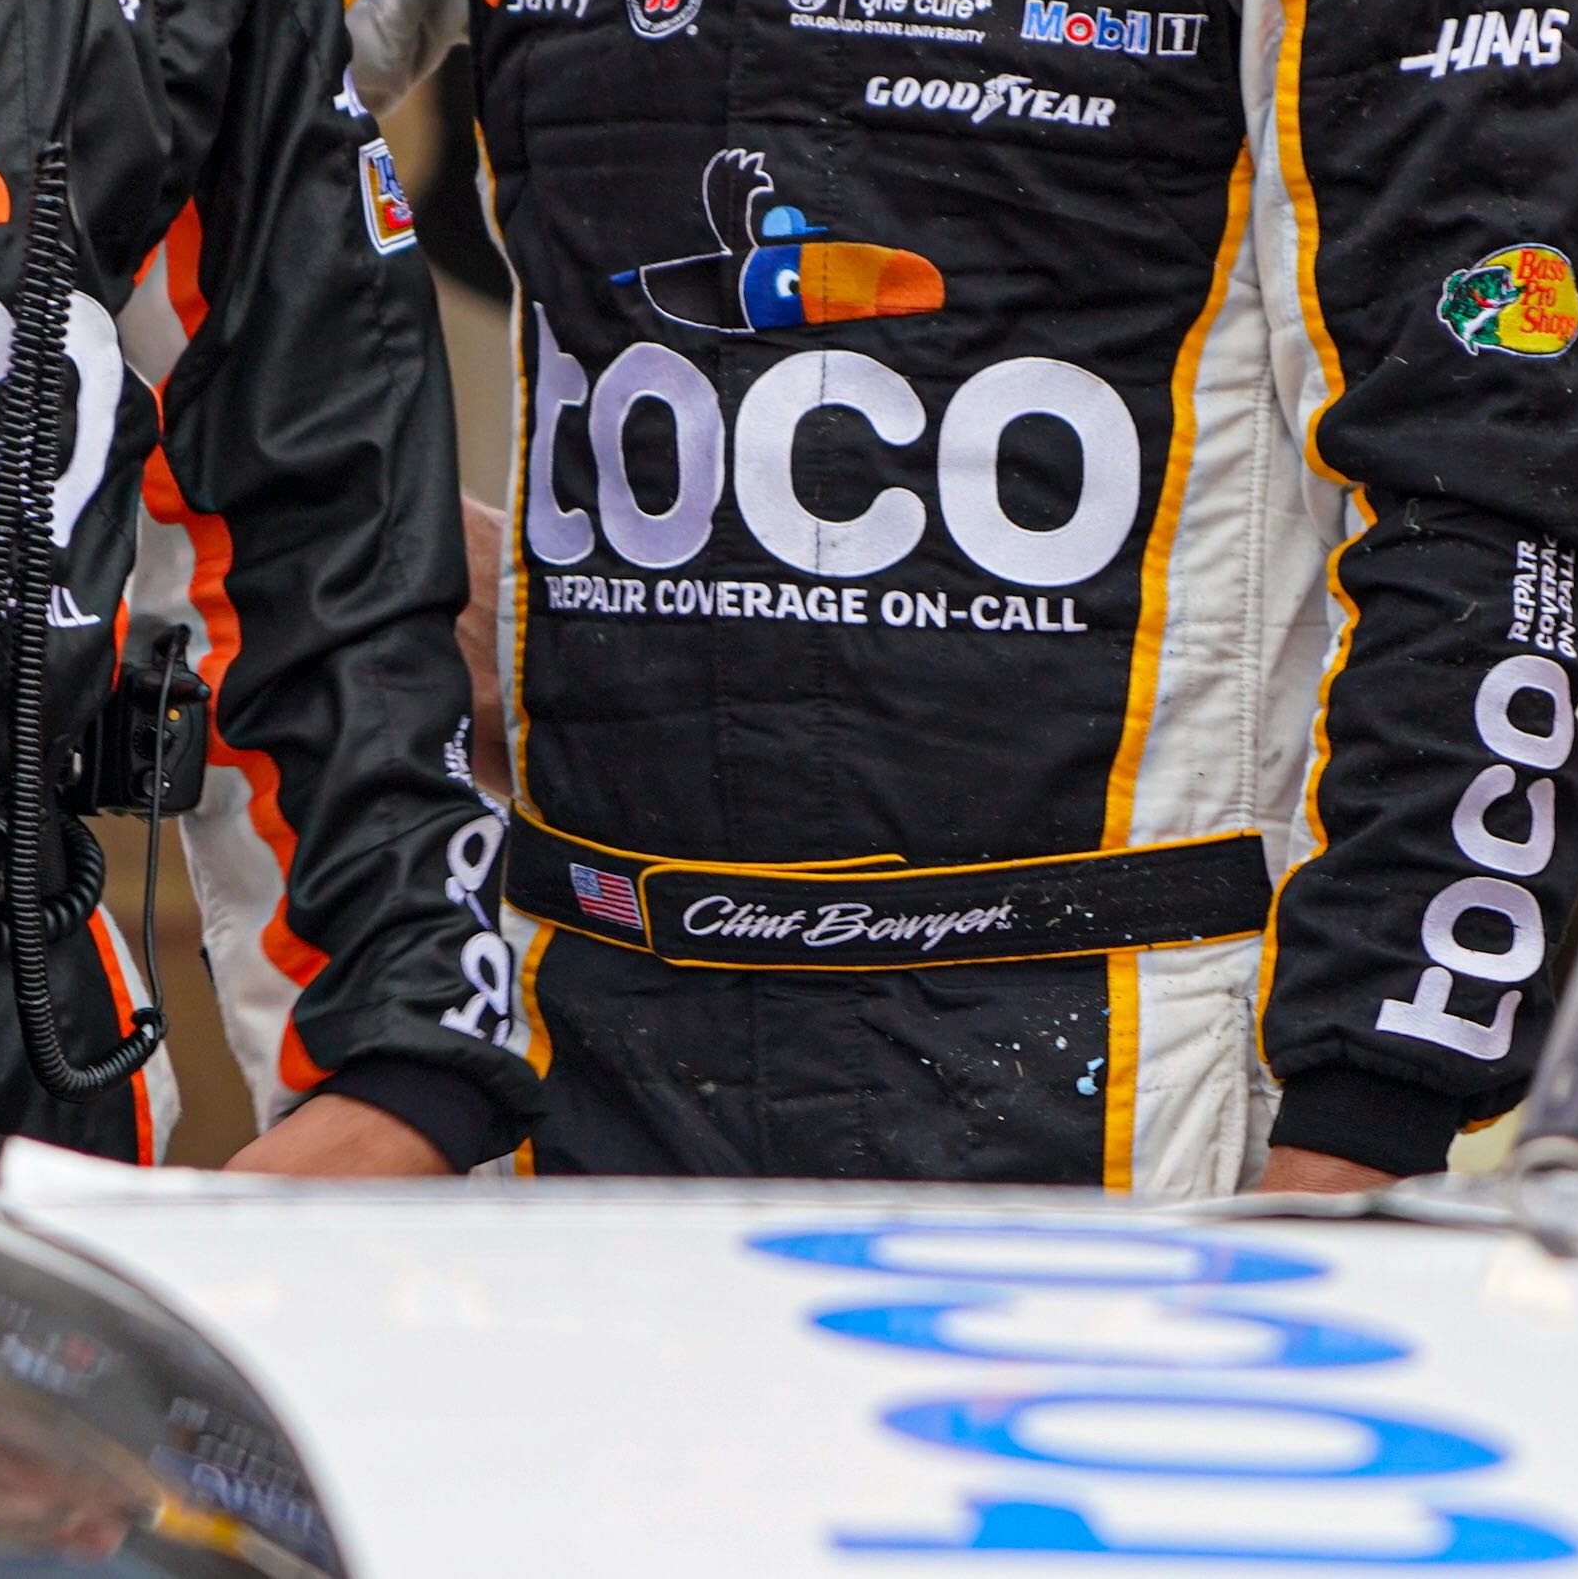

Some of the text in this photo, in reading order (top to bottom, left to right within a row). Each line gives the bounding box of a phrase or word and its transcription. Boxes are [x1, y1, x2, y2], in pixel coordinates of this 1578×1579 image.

[790, 13, 986, 44] COLORADO STATE UNIVERSITY
[1398, 7, 1571, 80] HAAS
[866, 73, 1117, 127] GOODYEAR
[1516, 248, 1567, 282] Bass
[1521, 278, 1556, 308] Pro
[526, 301, 1142, 588] toco
[544, 574, 1089, 633] REPAIR COVERAGE ON-CALL
[1506, 540, 1538, 643] REPAIR
[1376, 654, 1576, 1061] toco
[683, 894, 1014, 952] Clint Bowyer
